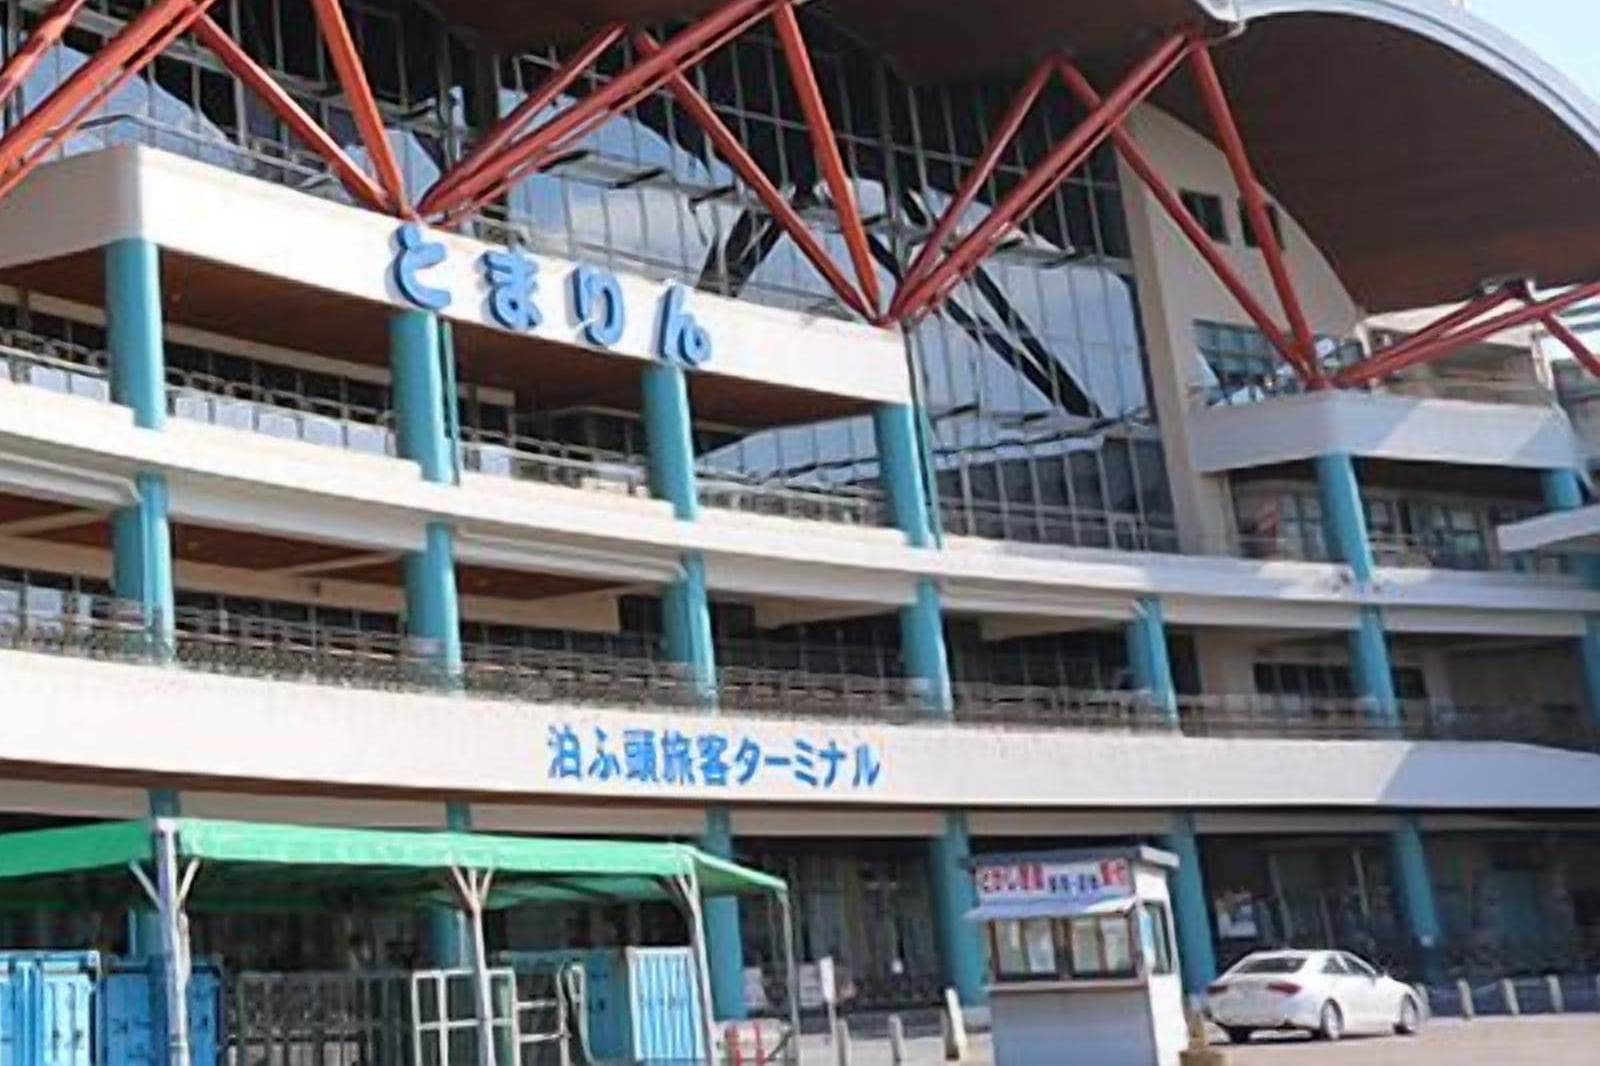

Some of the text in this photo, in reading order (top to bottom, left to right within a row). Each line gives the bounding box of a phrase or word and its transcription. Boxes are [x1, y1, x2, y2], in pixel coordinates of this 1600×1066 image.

[392, 223, 713, 366] とまりん
[546, 724, 882, 788] 泊ふ頭旅客ターミナル
